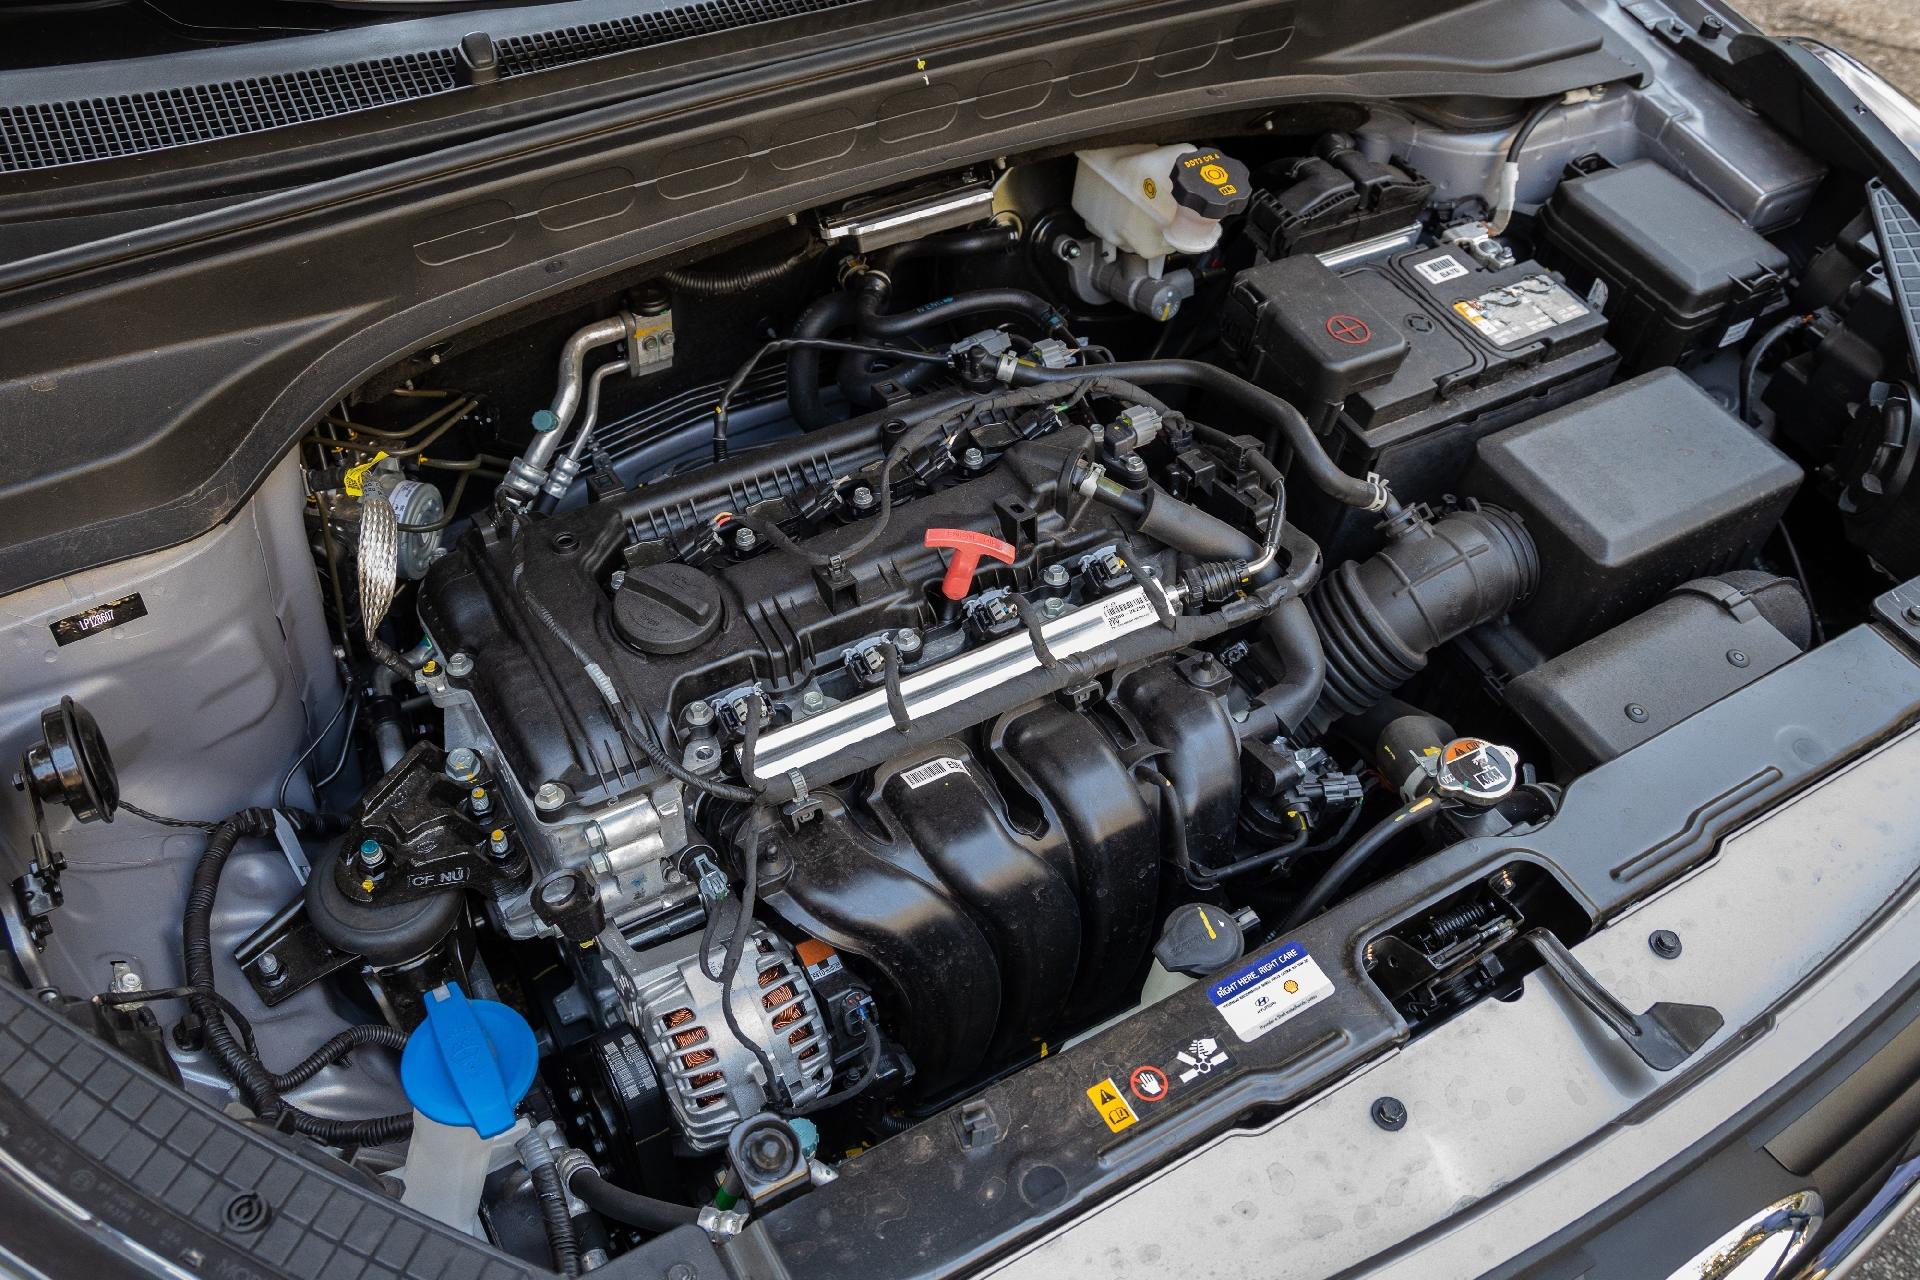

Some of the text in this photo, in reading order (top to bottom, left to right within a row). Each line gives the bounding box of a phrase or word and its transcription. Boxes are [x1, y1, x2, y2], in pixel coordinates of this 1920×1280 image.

[79, 609, 115, 631] LP128607
[1217, 948, 1298, 998] RIGHT HERE, RIGHT CARE
